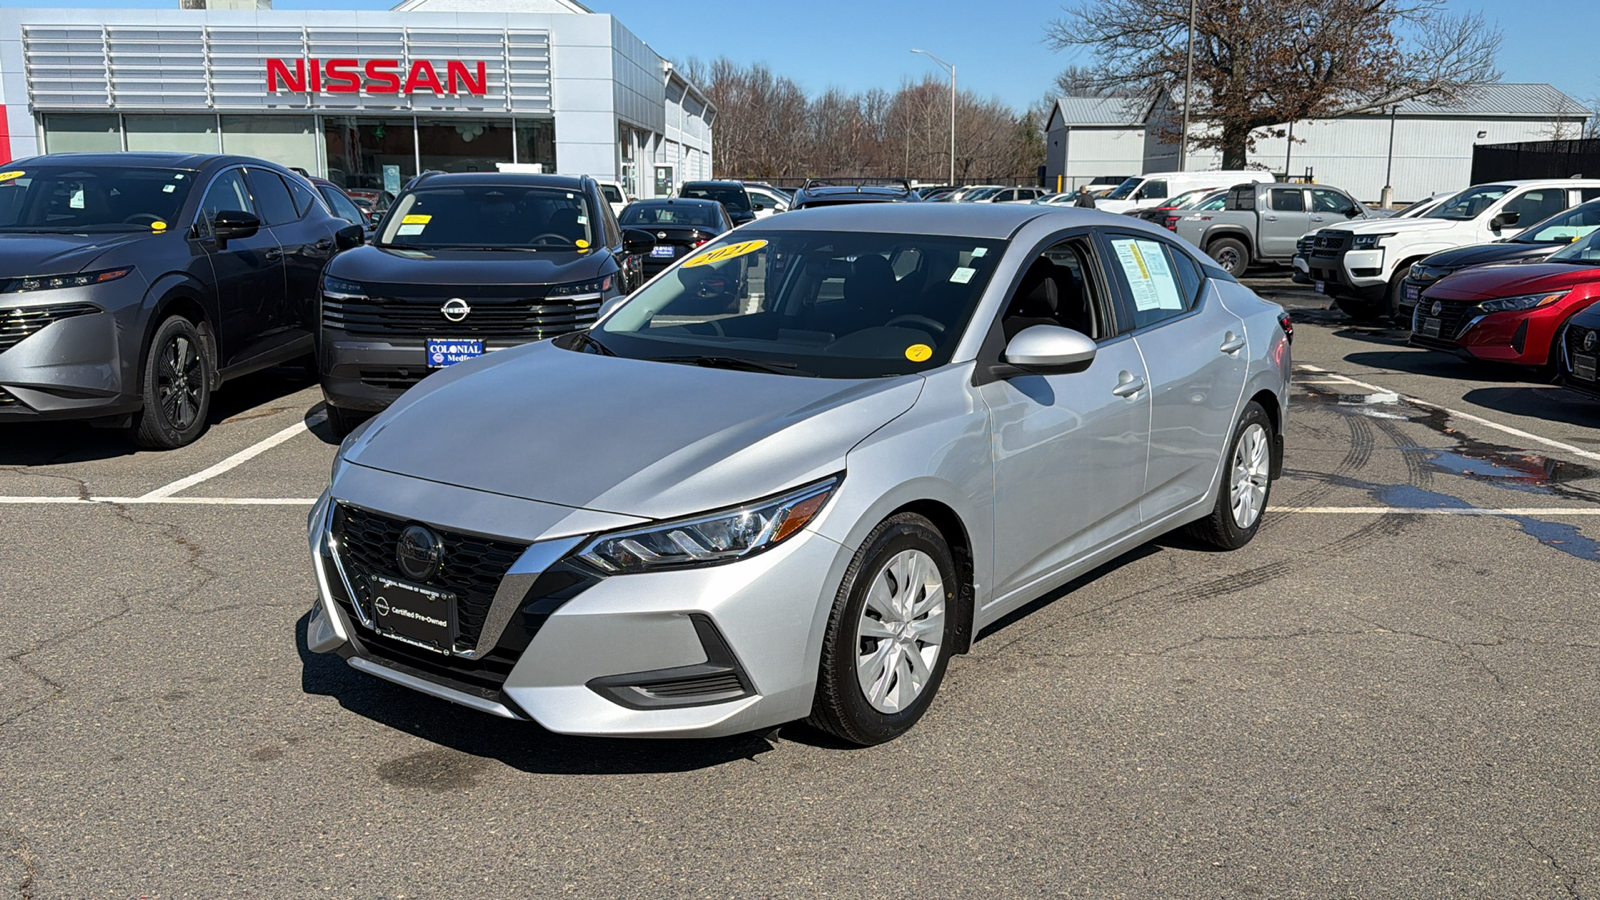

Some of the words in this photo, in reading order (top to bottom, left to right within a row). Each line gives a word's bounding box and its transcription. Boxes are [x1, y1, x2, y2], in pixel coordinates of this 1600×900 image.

[266, 58, 487, 95] NISSAN
[692, 242, 754, 265] 2021
[430, 345, 481, 354] COLONIAL
[391, 606, 415, 619] Certified
[415, 613, 447, 628] Pre-Owned
